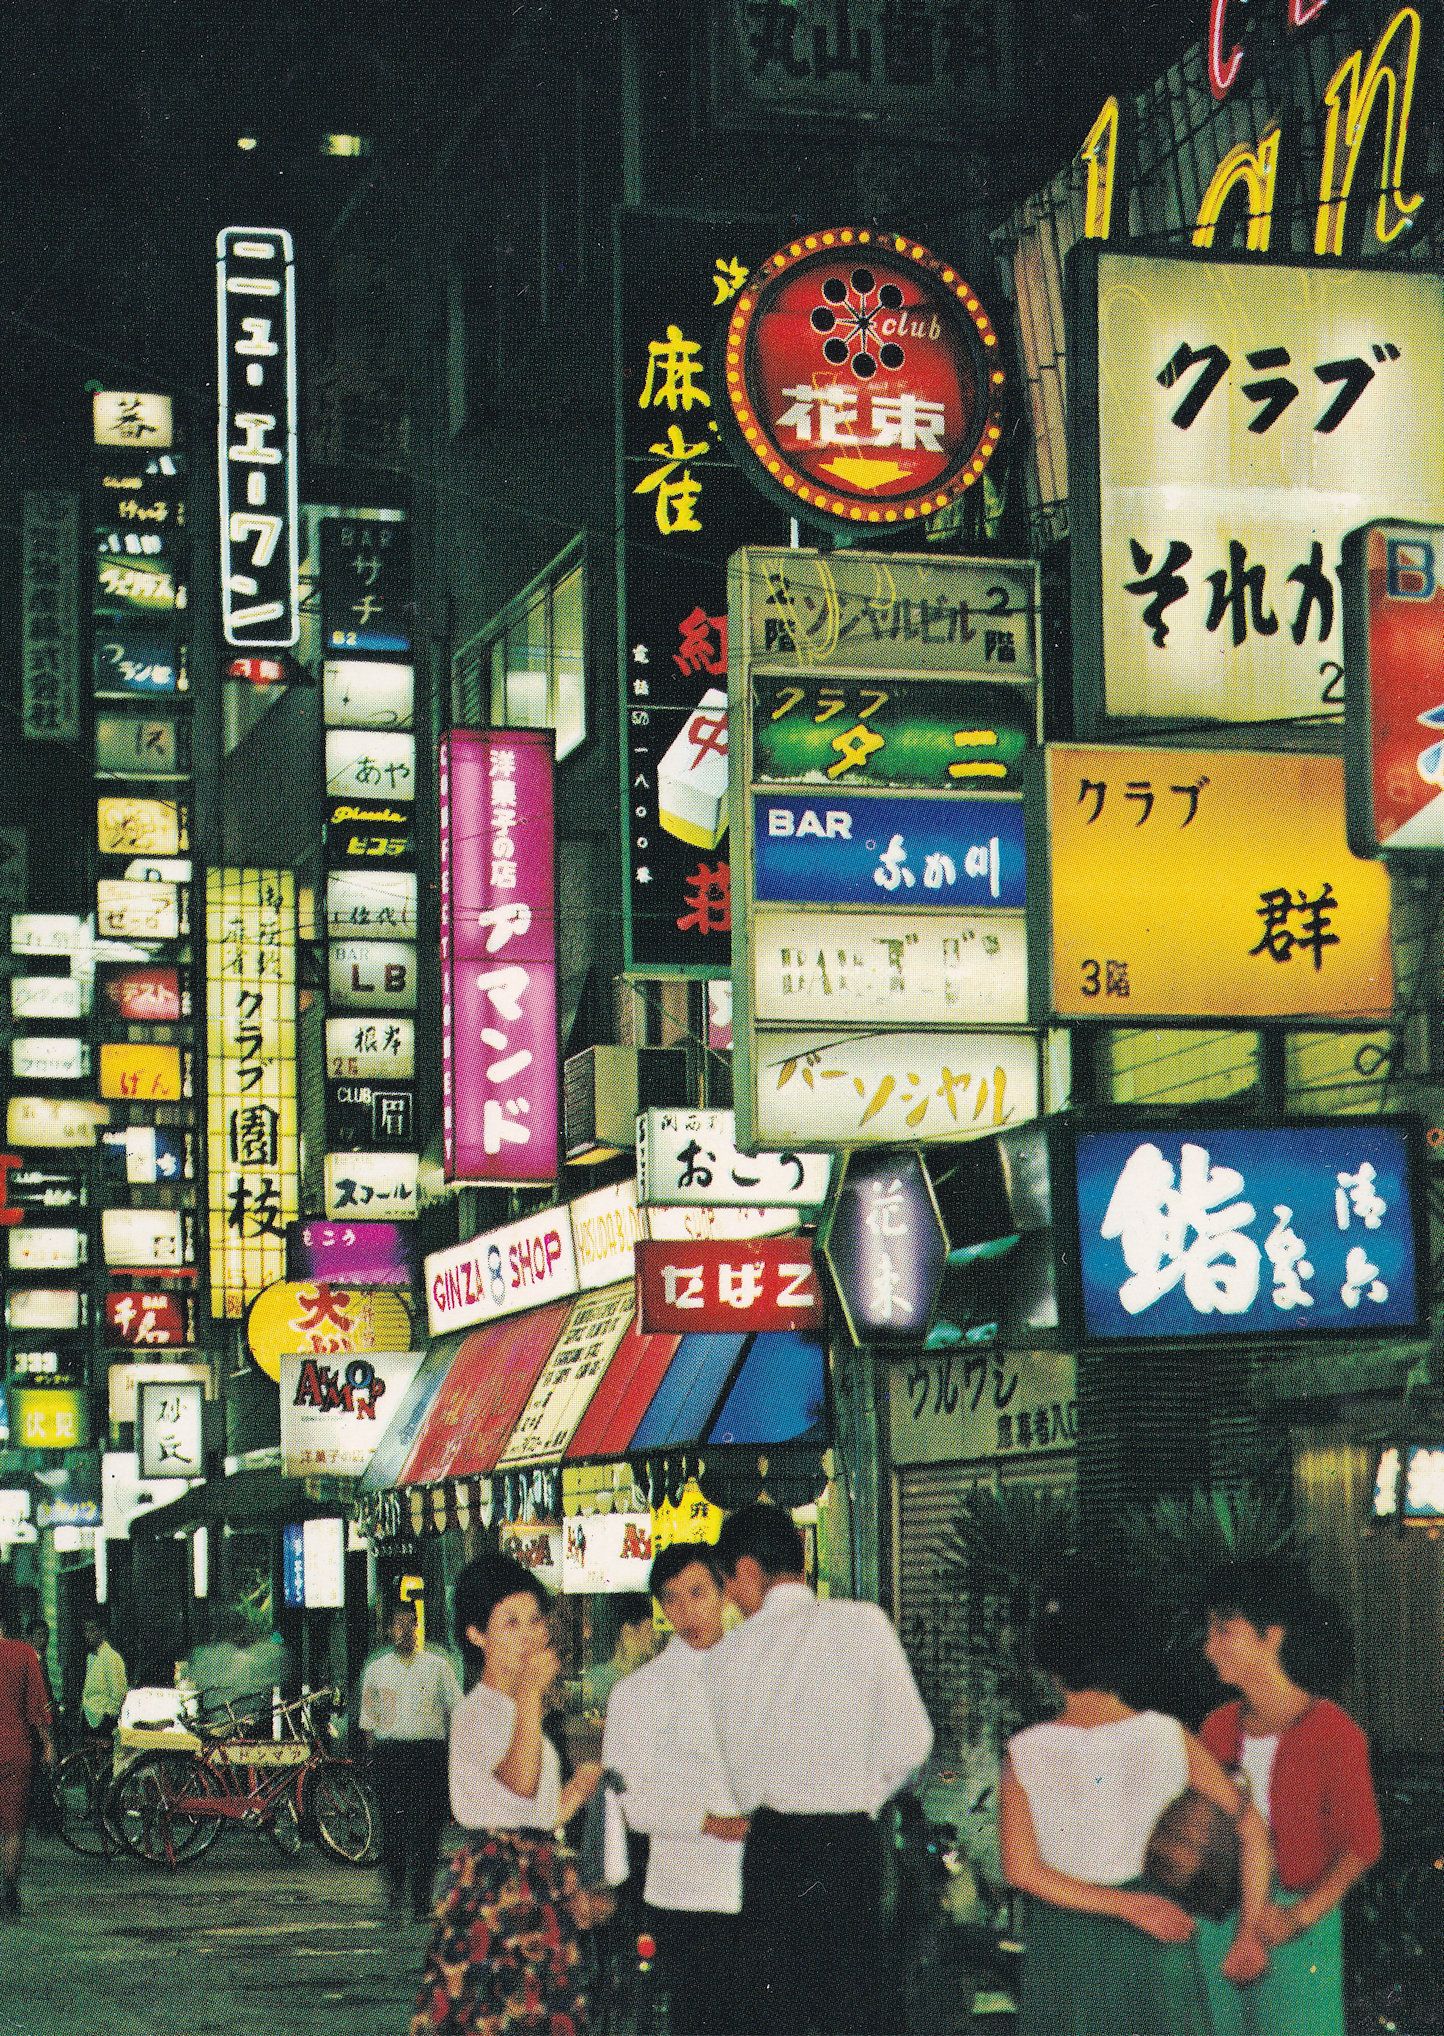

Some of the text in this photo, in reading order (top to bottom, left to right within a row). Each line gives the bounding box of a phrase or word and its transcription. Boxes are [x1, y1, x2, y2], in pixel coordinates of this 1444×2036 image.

[881, 312, 943, 342] club
[777, 384, 948, 452] 花束
[1156, 342, 1400, 434] クラブ
[228, 241, 283, 628] ニューエーワン
[634, 325, 711, 535] 麻雀
[352, 554, 382, 625] サチ
[355, 756, 410, 789] あや
[827, 724, 1007, 779] タニ
[489, 749, 517, 889] 洋菓子の店
[768, 808, 853, 840] BAR
[1077, 776, 1210, 828] クラブ
[1249, 883, 1341, 970] 群
[1080, 958, 1131, 999] 3階
[235, 991, 272, 1092] クラブ
[476, 902, 533, 1155] アマンド
[337, 1086, 372, 1104] CLUB
[333, 1177, 413, 1209] スコール
[433, 1262, 484, 1313] GINZA
[508, 1230, 562, 1291] SHOP
[662, 1262, 815, 1310] たばこ
